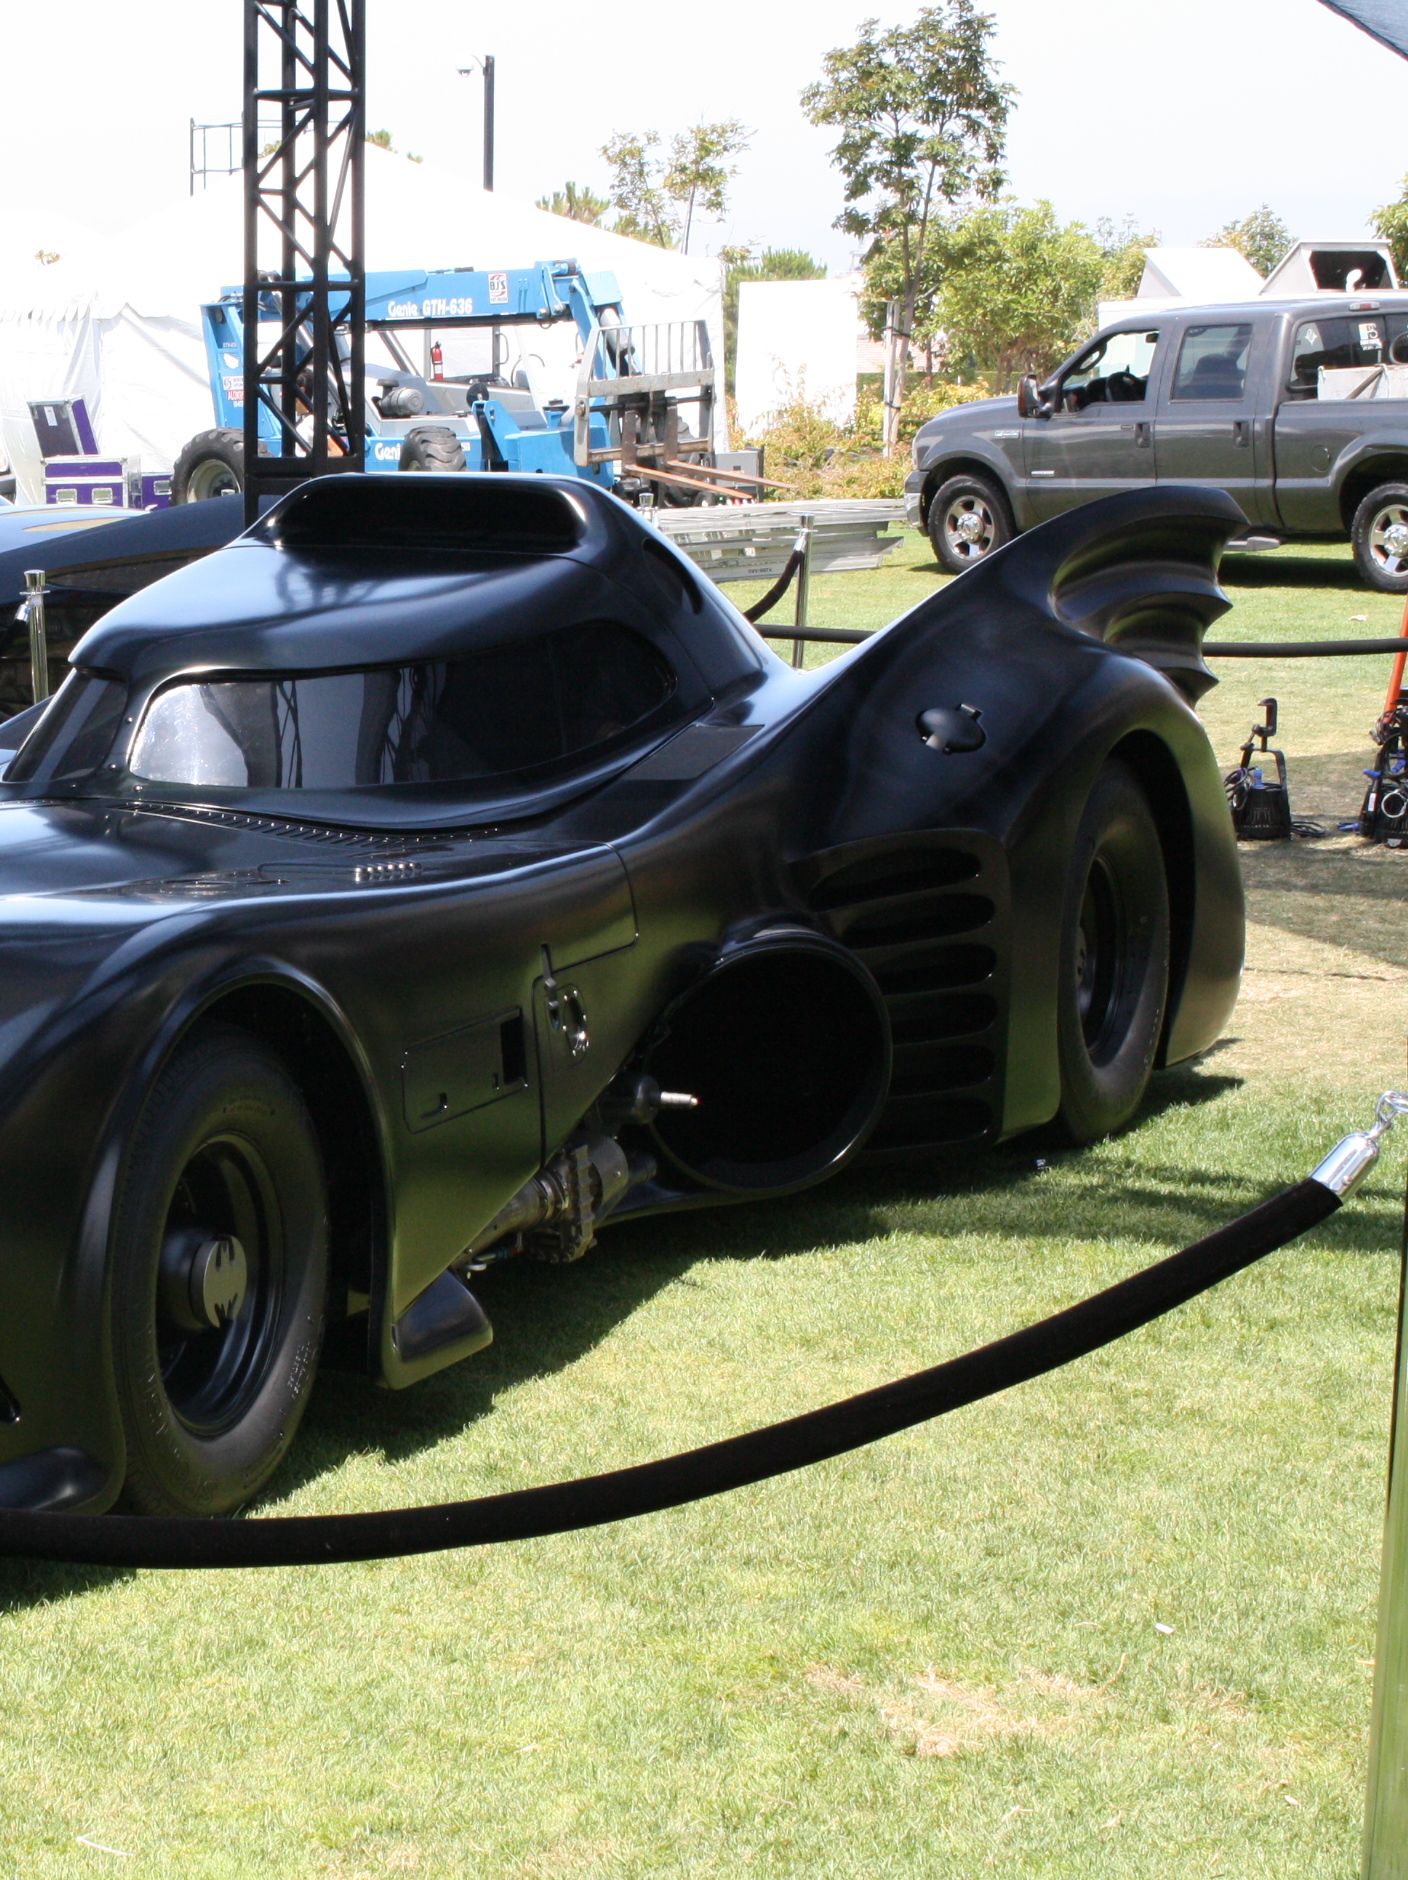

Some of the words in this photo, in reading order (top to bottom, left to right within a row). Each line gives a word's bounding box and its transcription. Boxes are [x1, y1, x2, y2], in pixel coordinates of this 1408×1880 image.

[388, 301, 418, 317] Genie
[422, 298, 473, 316] GTH-636
[374, 442, 401, 461] Geni
